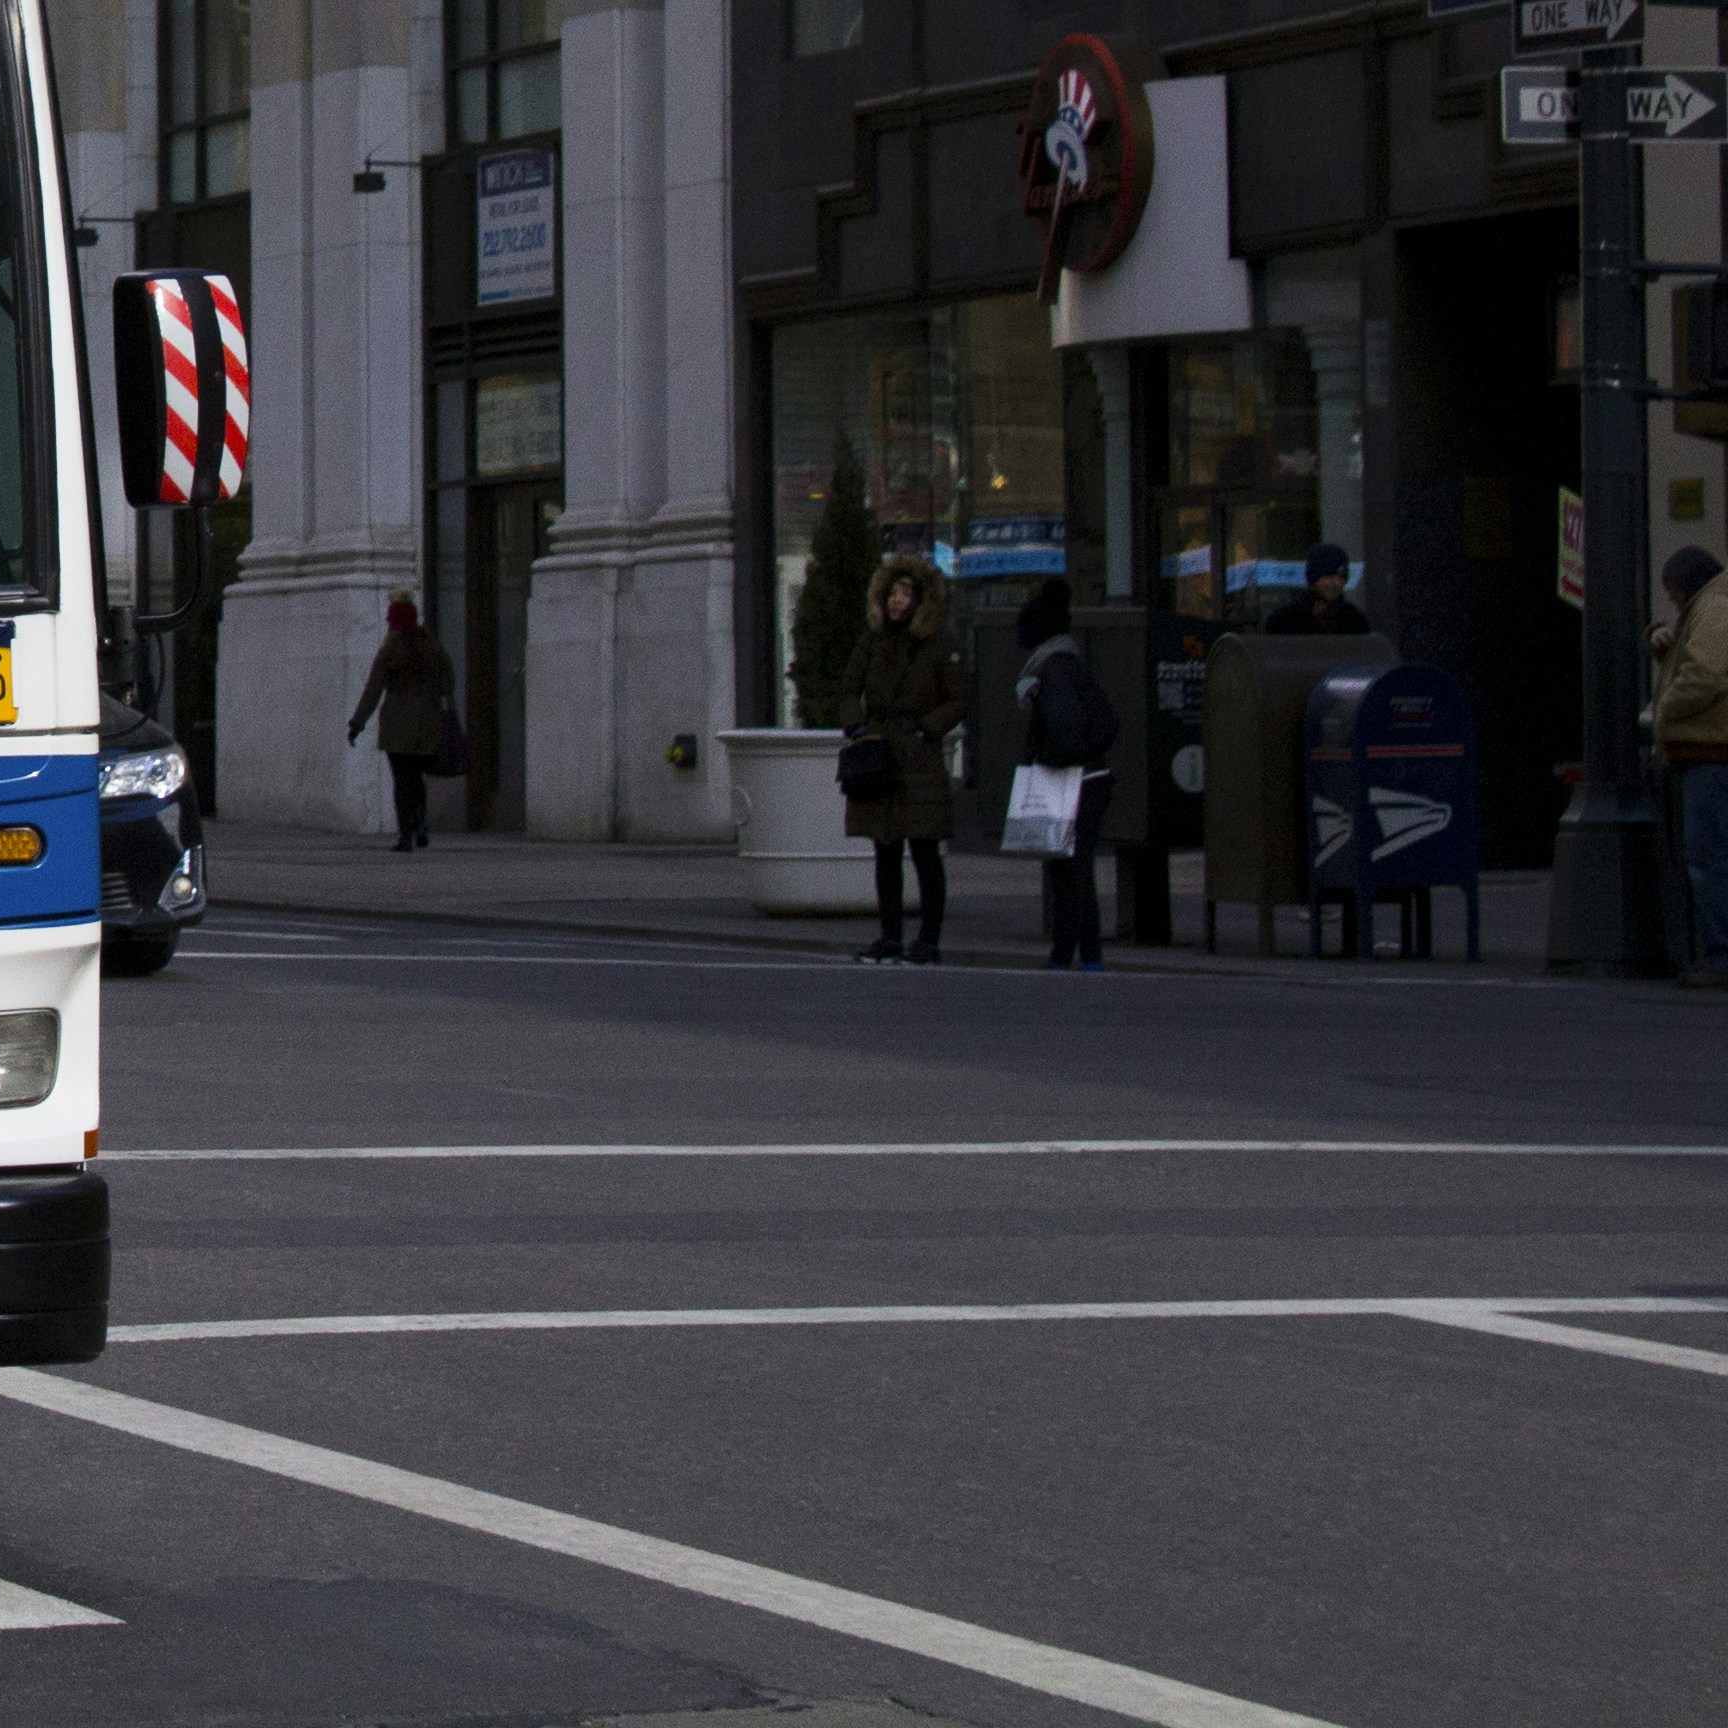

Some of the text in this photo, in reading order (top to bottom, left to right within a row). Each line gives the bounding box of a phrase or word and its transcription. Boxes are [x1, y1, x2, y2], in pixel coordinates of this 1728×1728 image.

[1531, 1, 1568, 32] ONE
[1537, 92, 1693, 118] ON WAY
